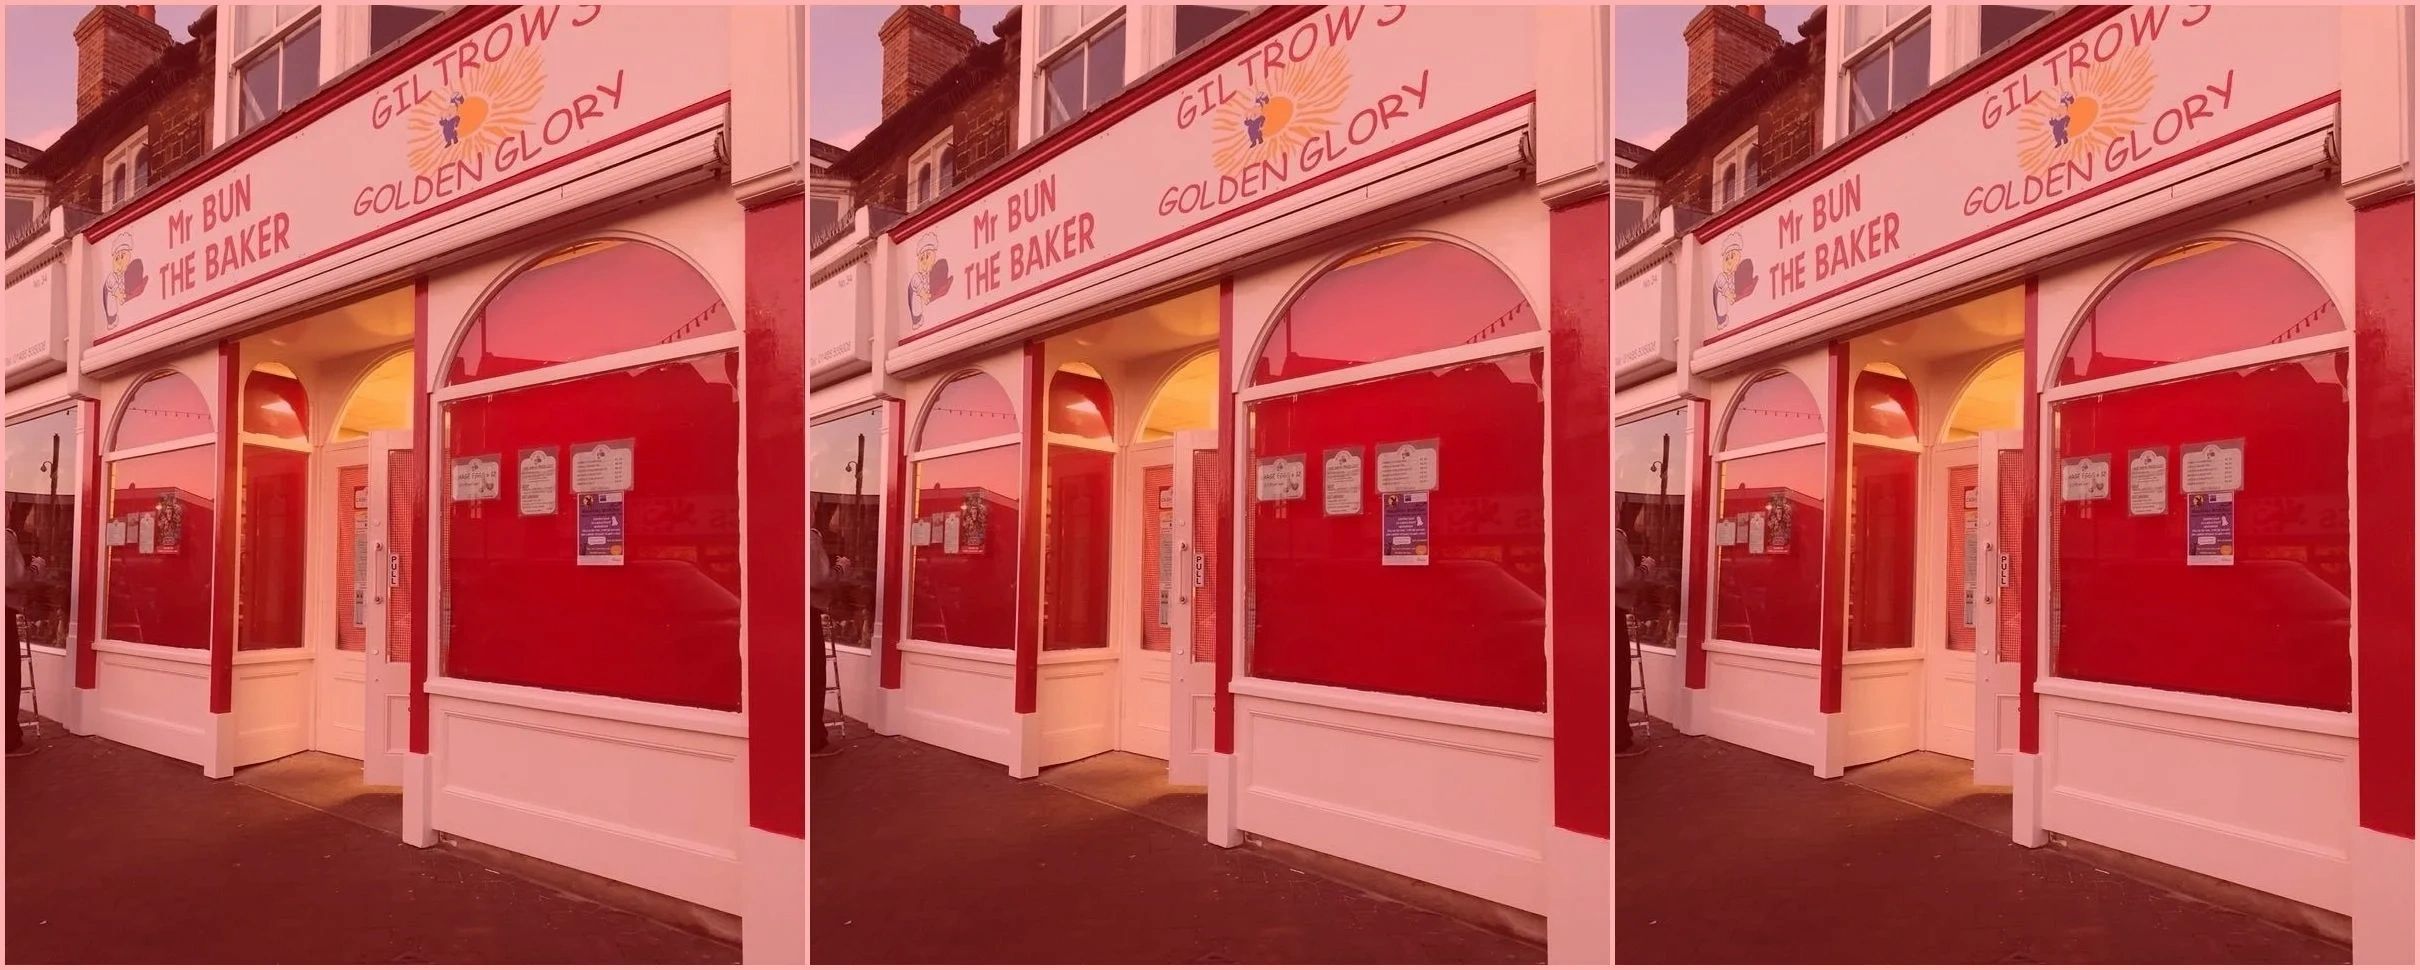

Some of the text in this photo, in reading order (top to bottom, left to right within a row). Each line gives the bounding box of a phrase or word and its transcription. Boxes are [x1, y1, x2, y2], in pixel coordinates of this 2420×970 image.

[354, 69, 623, 216] GOLDEN GLORY
[1159, 69, 1428, 216] GOLDEN GLORY
[1964, 69, 2233, 216] GOLDEN GLORY
[169, 174, 251, 249] Mr BUN
[974, 174, 1056, 249] Mr BUN
[1779, 174, 1861, 249] Mr BUN
[160, 212, 290, 300] THE BAKER
[965, 212, 1095, 300] THE BAKER
[1770, 212, 1900, 300] THE BAKER
